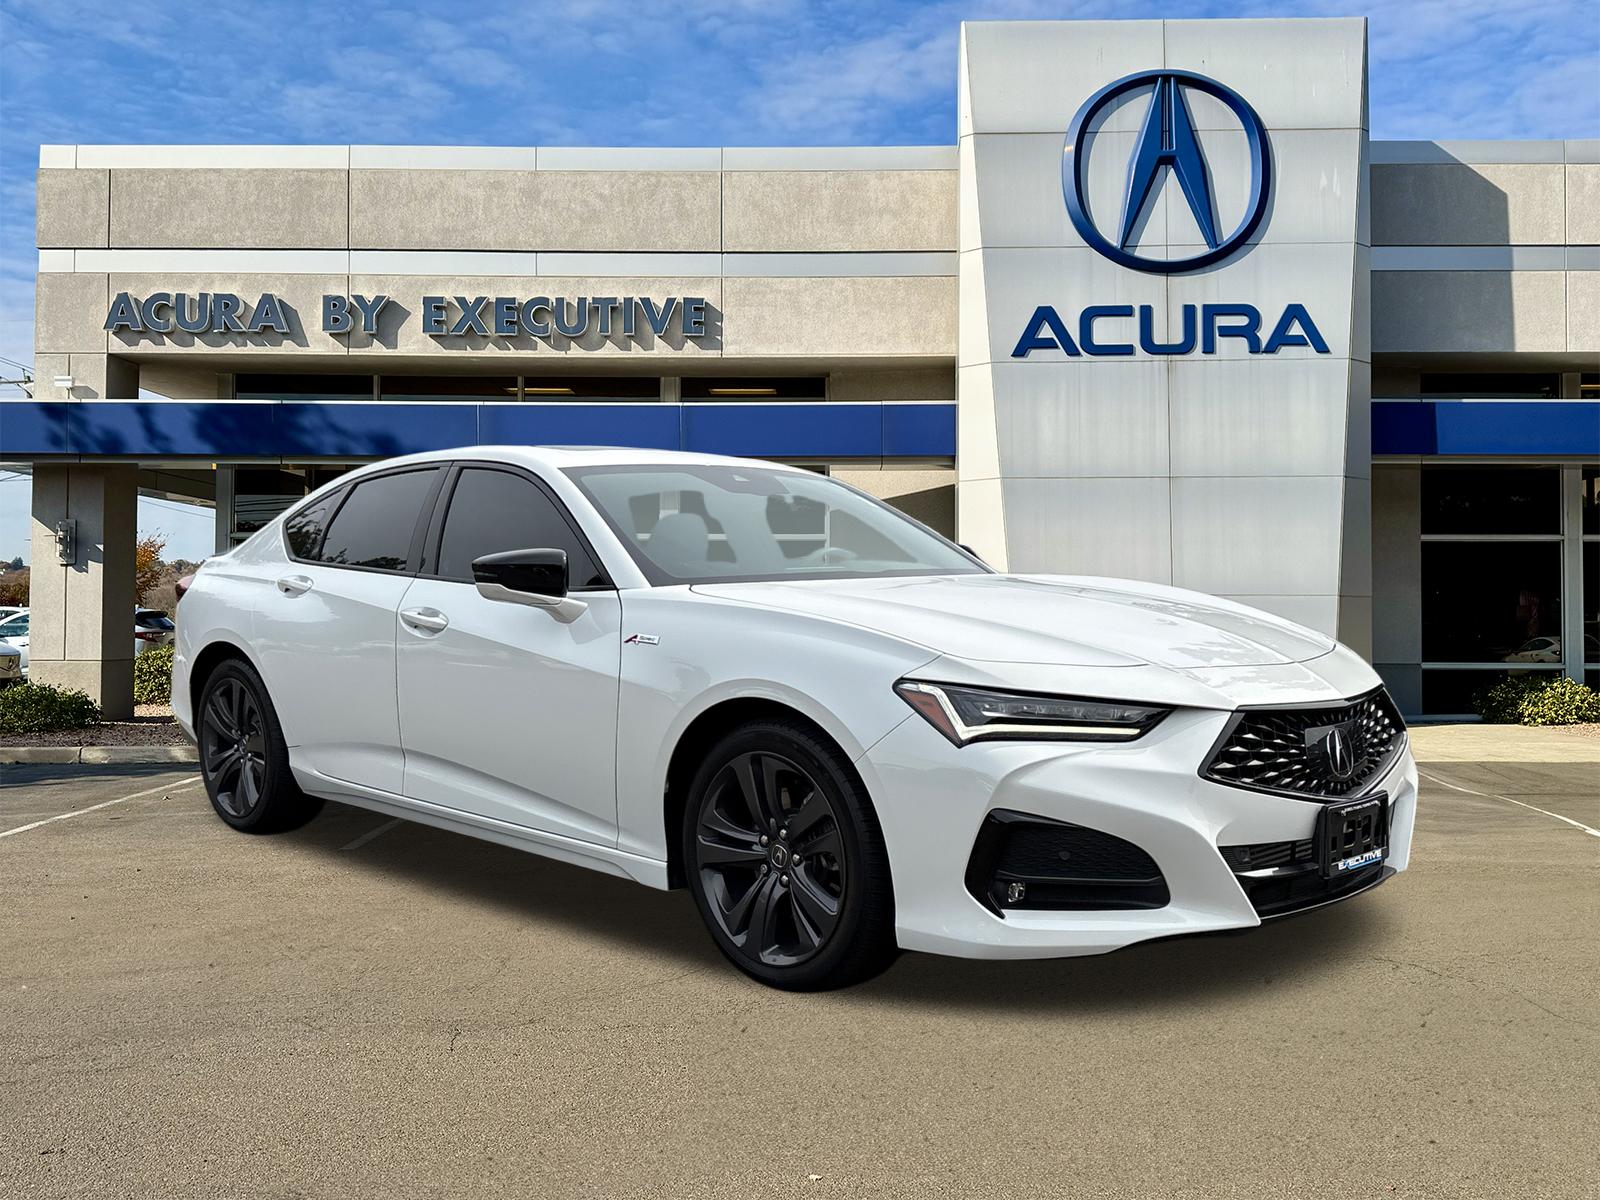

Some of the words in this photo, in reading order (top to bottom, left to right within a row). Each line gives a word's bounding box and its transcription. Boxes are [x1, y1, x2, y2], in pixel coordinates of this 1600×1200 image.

[104, 291, 289, 334] ACURA
[322, 294, 391, 335] BY
[423, 295, 707, 337] EXECUTIVE
[1011, 303, 1332, 358] ACURA
[1338, 849, 1382, 870] EXECUTIVE
